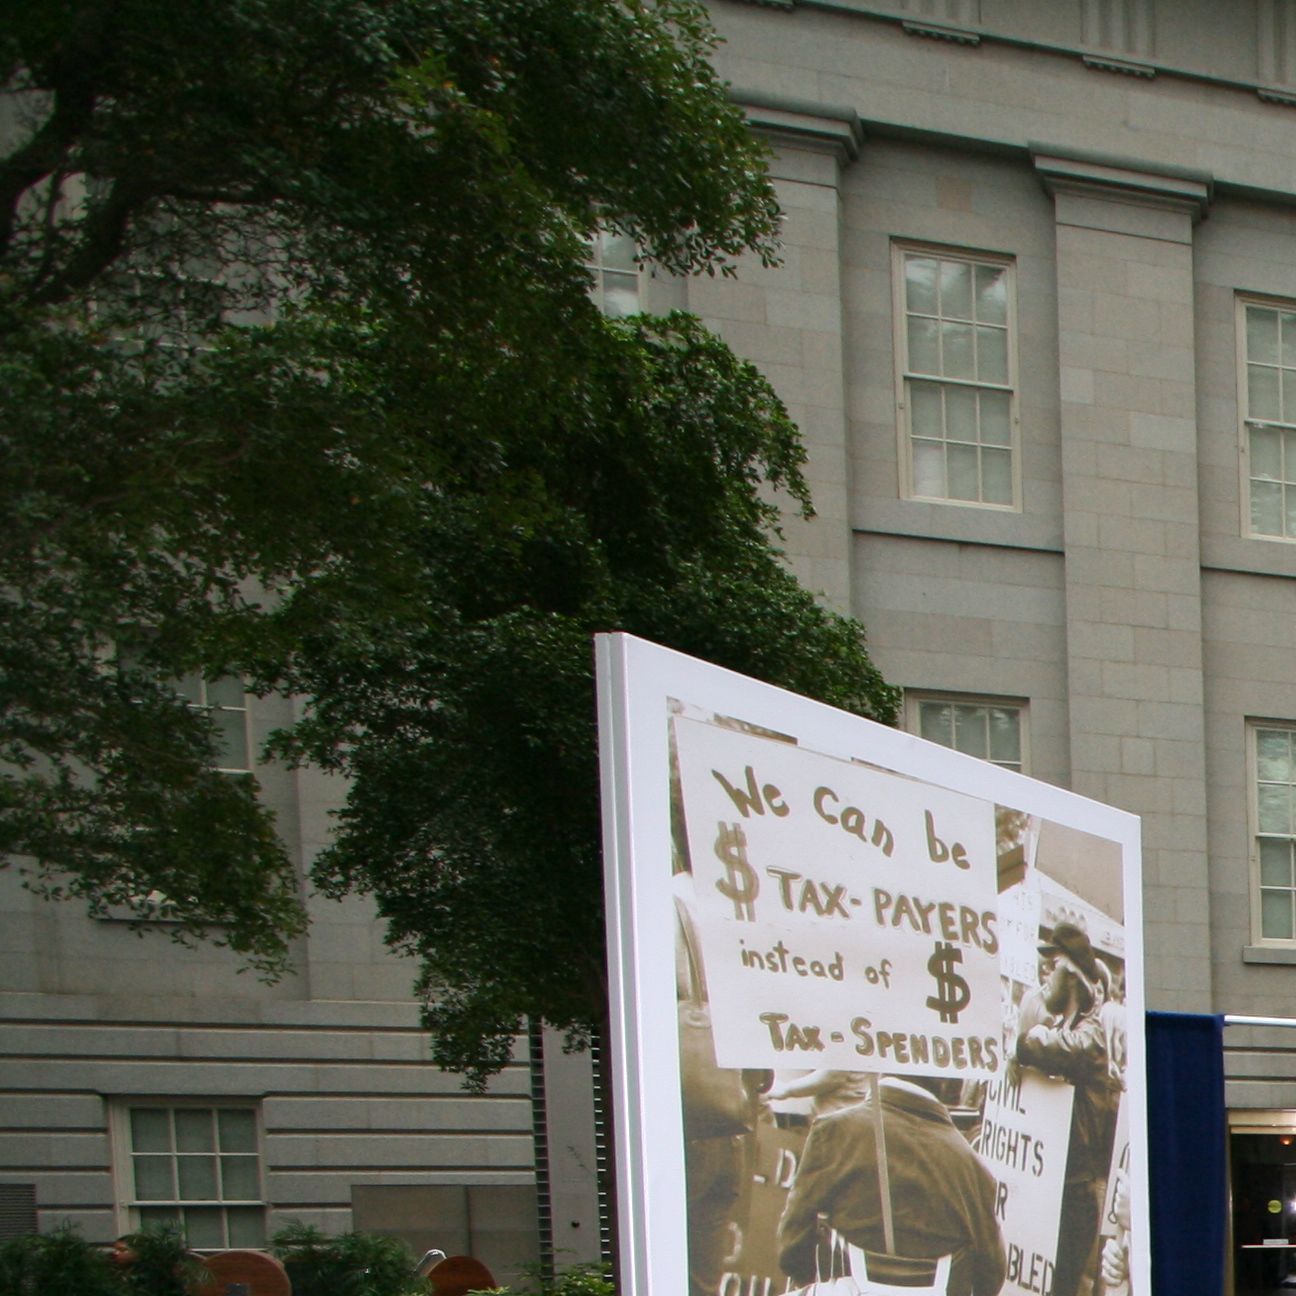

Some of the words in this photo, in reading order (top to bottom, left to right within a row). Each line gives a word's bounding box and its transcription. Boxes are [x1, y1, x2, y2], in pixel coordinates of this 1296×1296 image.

[711, 765, 790, 818] We
[925, 810, 970, 870] be
[739, 939, 845, 982] instead
[864, 958, 893, 989] of
[926, 941, 971, 1024] $
[983, 1119, 1044, 1177] RIGHTS
